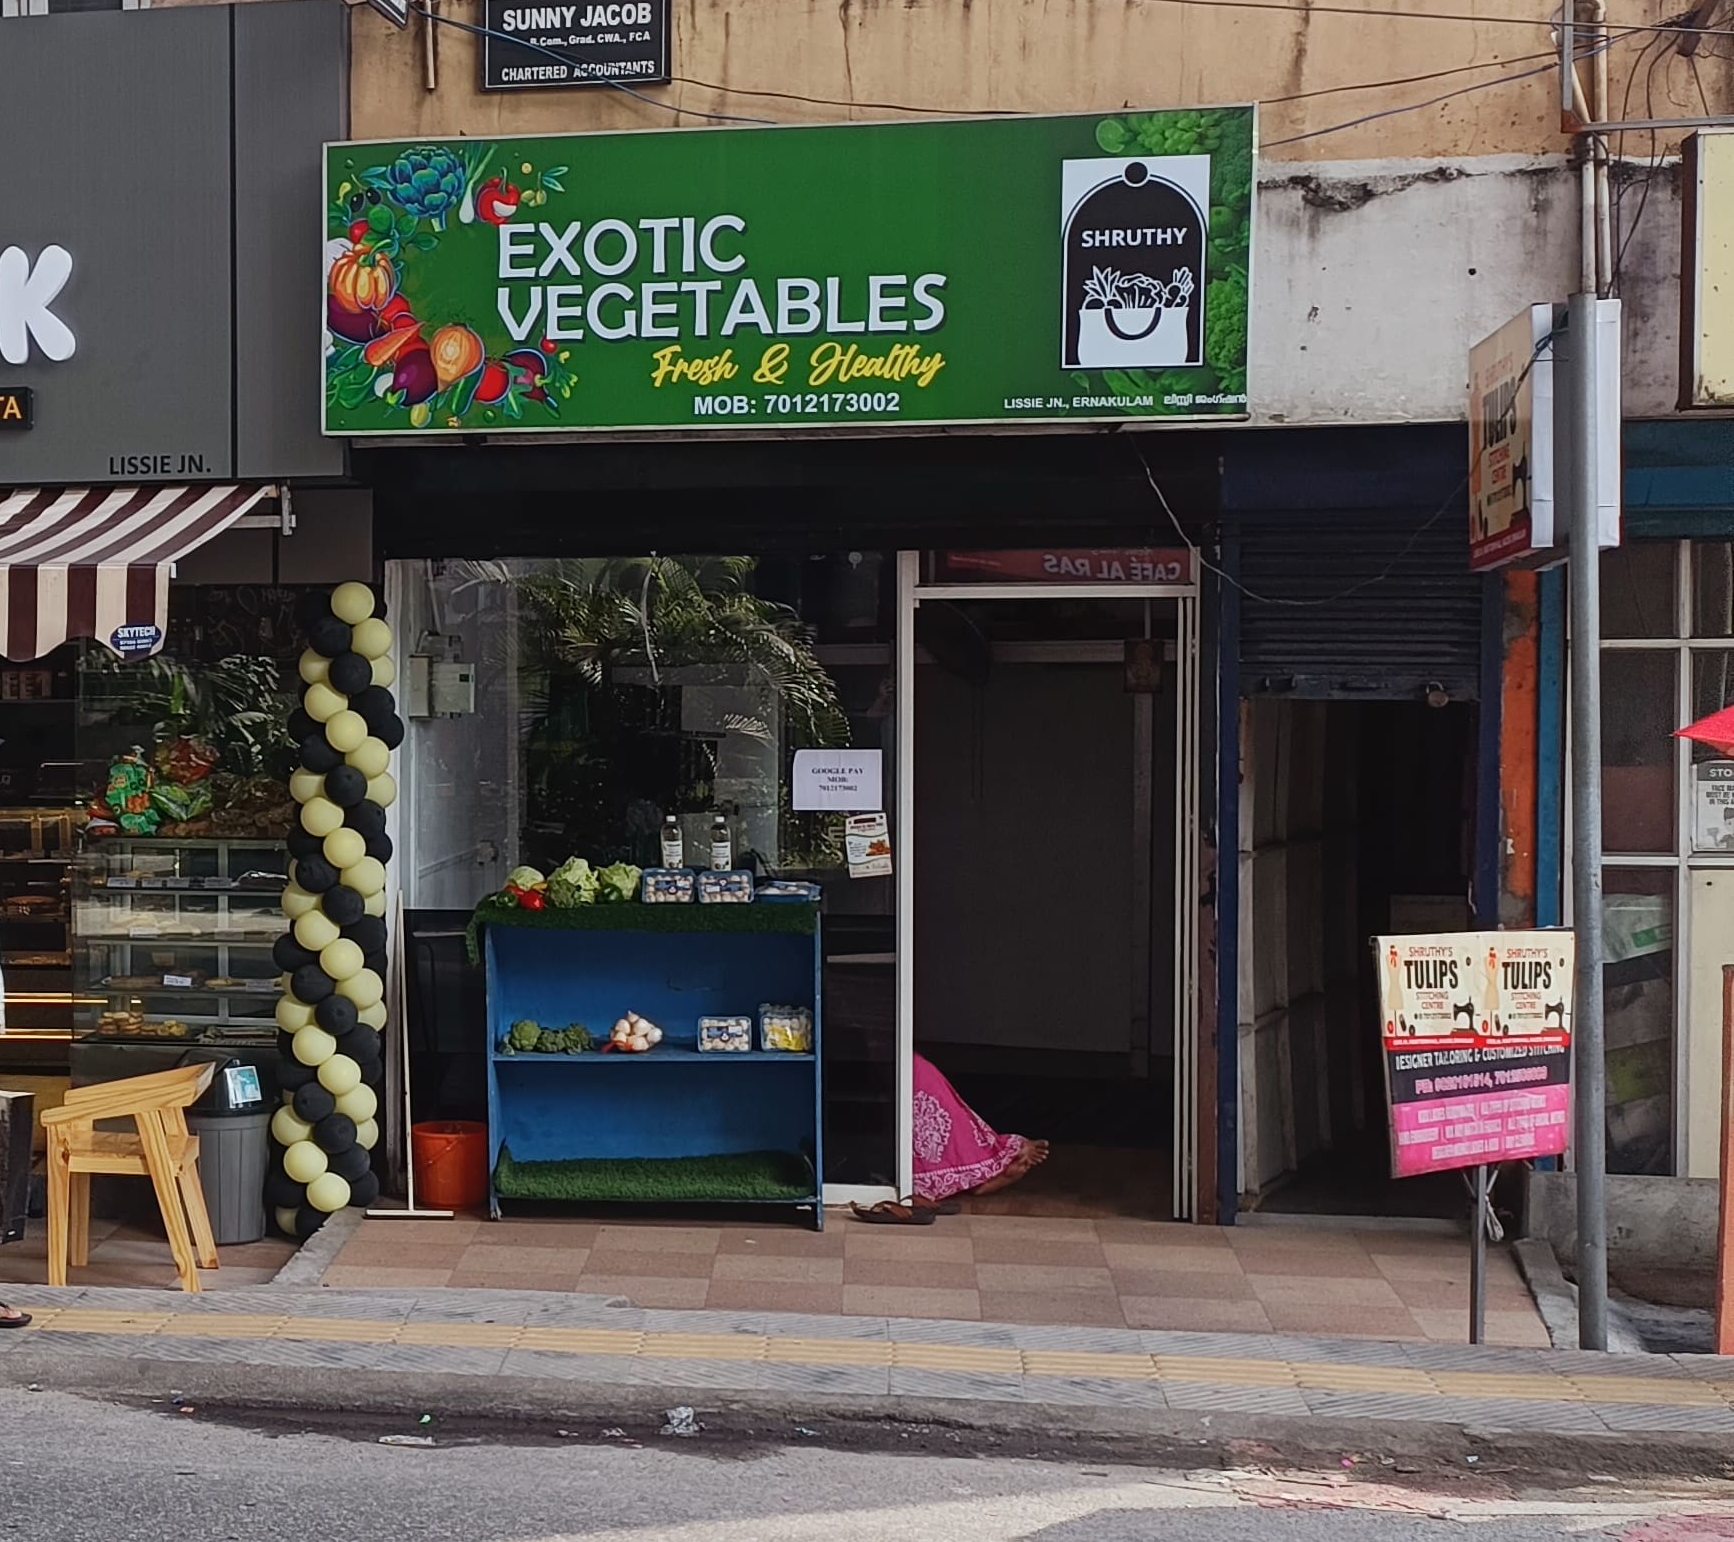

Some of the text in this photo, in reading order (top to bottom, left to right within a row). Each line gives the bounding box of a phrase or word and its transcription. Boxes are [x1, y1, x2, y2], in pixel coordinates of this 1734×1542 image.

[502, 3, 652, 31] SUNNY JACOB
[629, 31, 651, 41] FCA
[501, 60, 655, 81] CHARTERED ACCOUNTANTS
[498, 215, 747, 278] EXOTIC
[1081, 227, 1187, 247] SHRUTHY
[497, 273, 947, 341] VEGETABLES
[651, 341, 946, 388] Fresh & Healthy
[694, 393, 900, 415] MOB: 7012173002
[1004, 397, 1043, 408] LISSIE
[1073, 396, 1154, 408] ERNAKULAM
[109, 454, 212, 475] LISSIE JN.
[811, 767, 846, 775] GOOGLE
[1408, 946, 1453, 958] SHRUTHY'S
[1507, 948, 1548, 959] SHRUTHY'S
[1403, 960, 1459, 990] TULIPS
[1502, 961, 1552, 990] TULIPS
